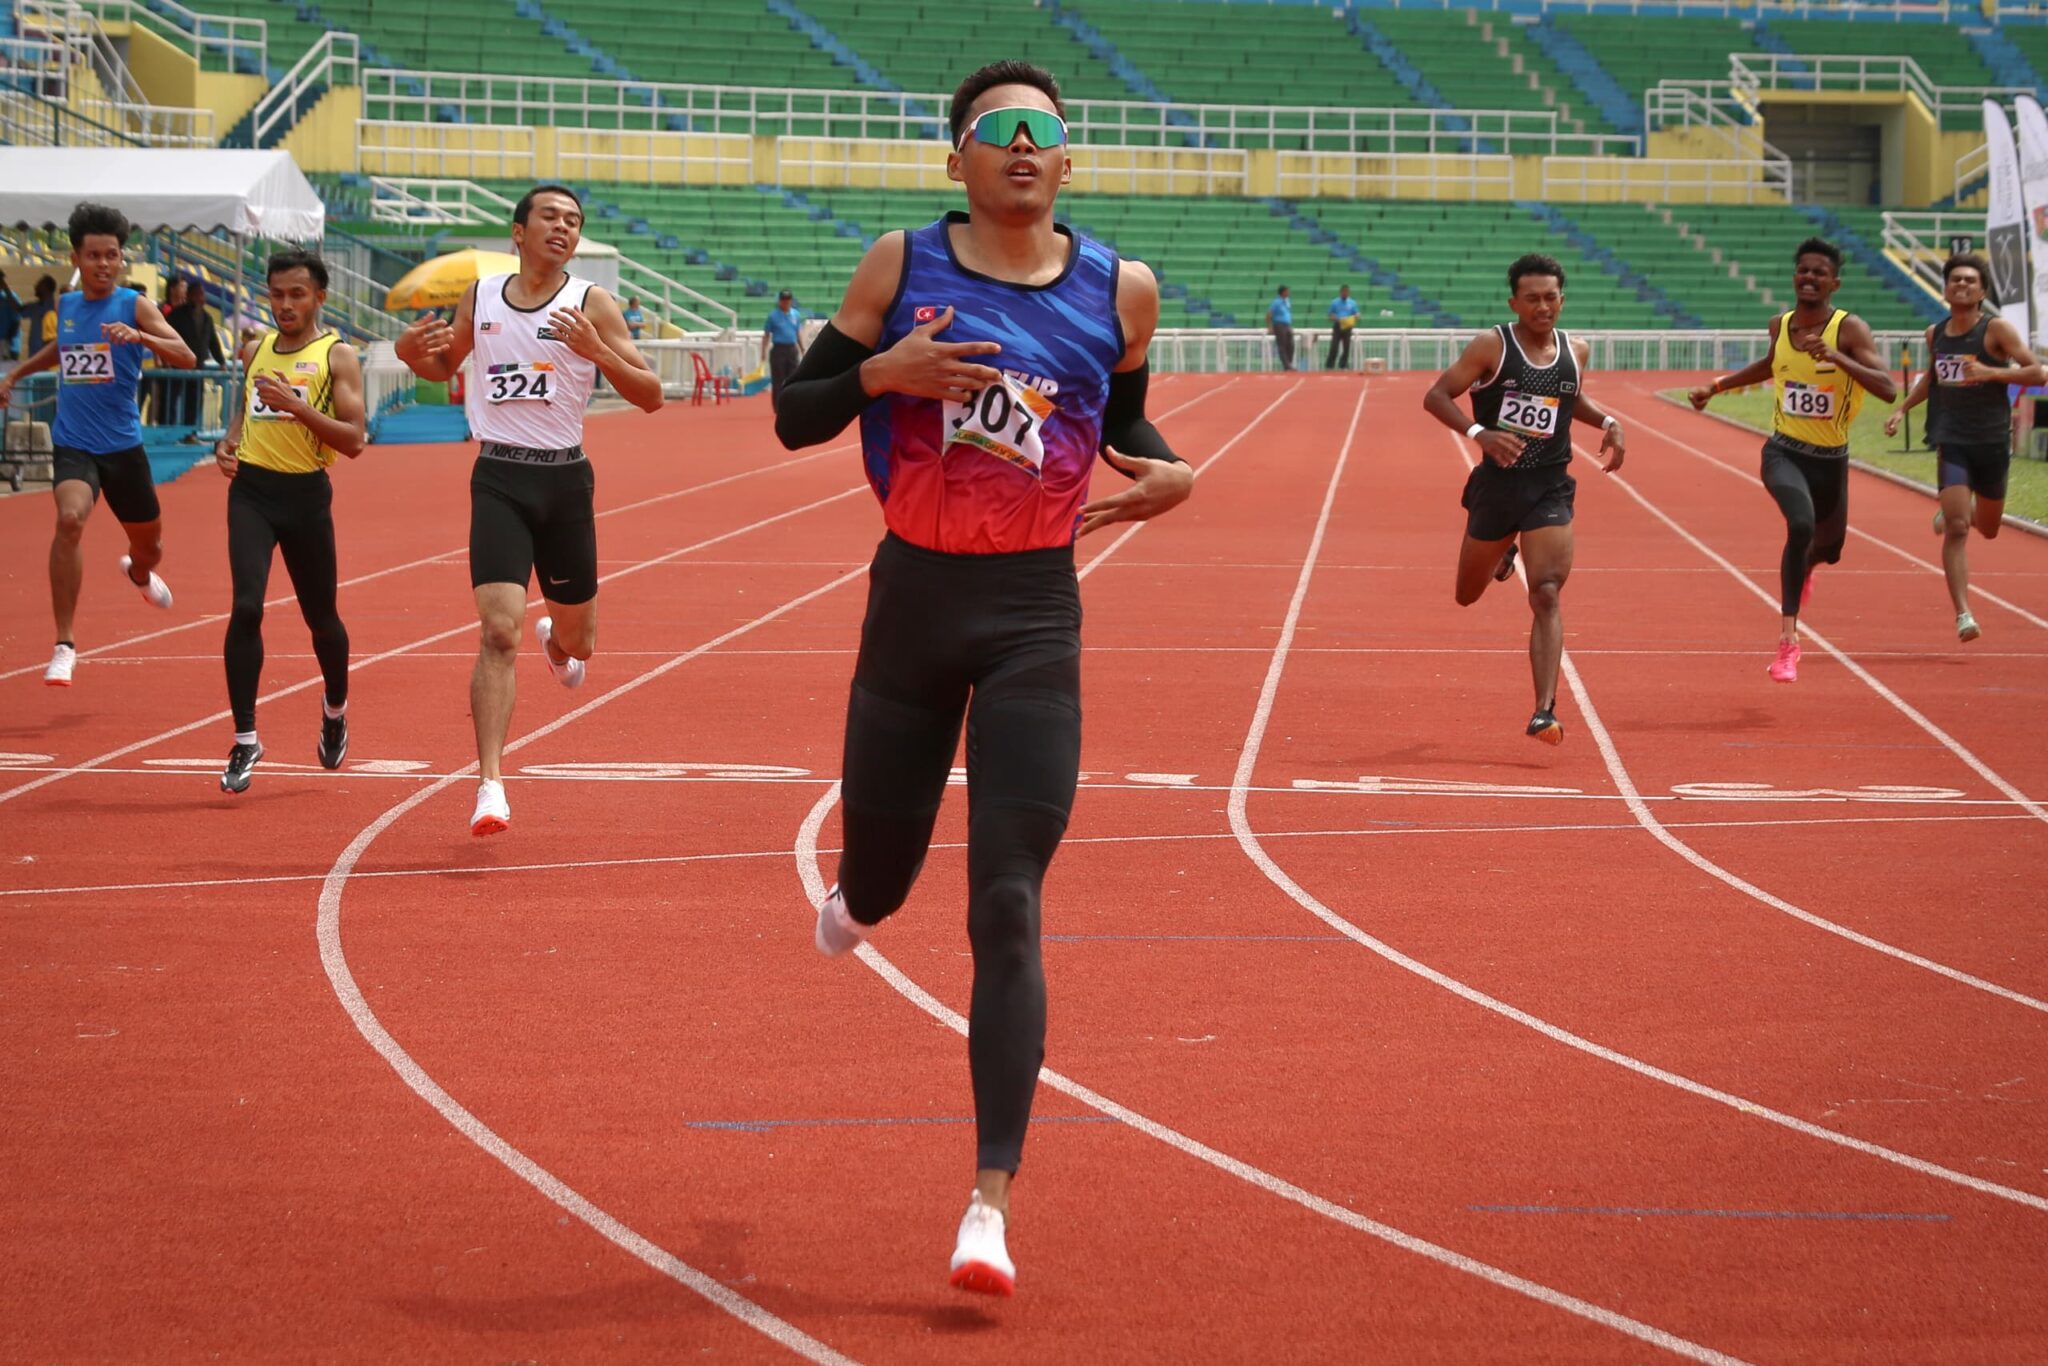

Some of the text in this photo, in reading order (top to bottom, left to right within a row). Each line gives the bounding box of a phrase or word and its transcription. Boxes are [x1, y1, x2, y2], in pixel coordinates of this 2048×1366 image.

[65, 353, 109, 375] 222
[1939, 362, 1969, 379] 37
[490, 373, 549, 399] 324
[1788, 391, 1829, 414] 189
[1503, 400, 1552, 430] 269
[489, 444, 523, 460] NIKE
[524, 448, 558, 463] PRO
